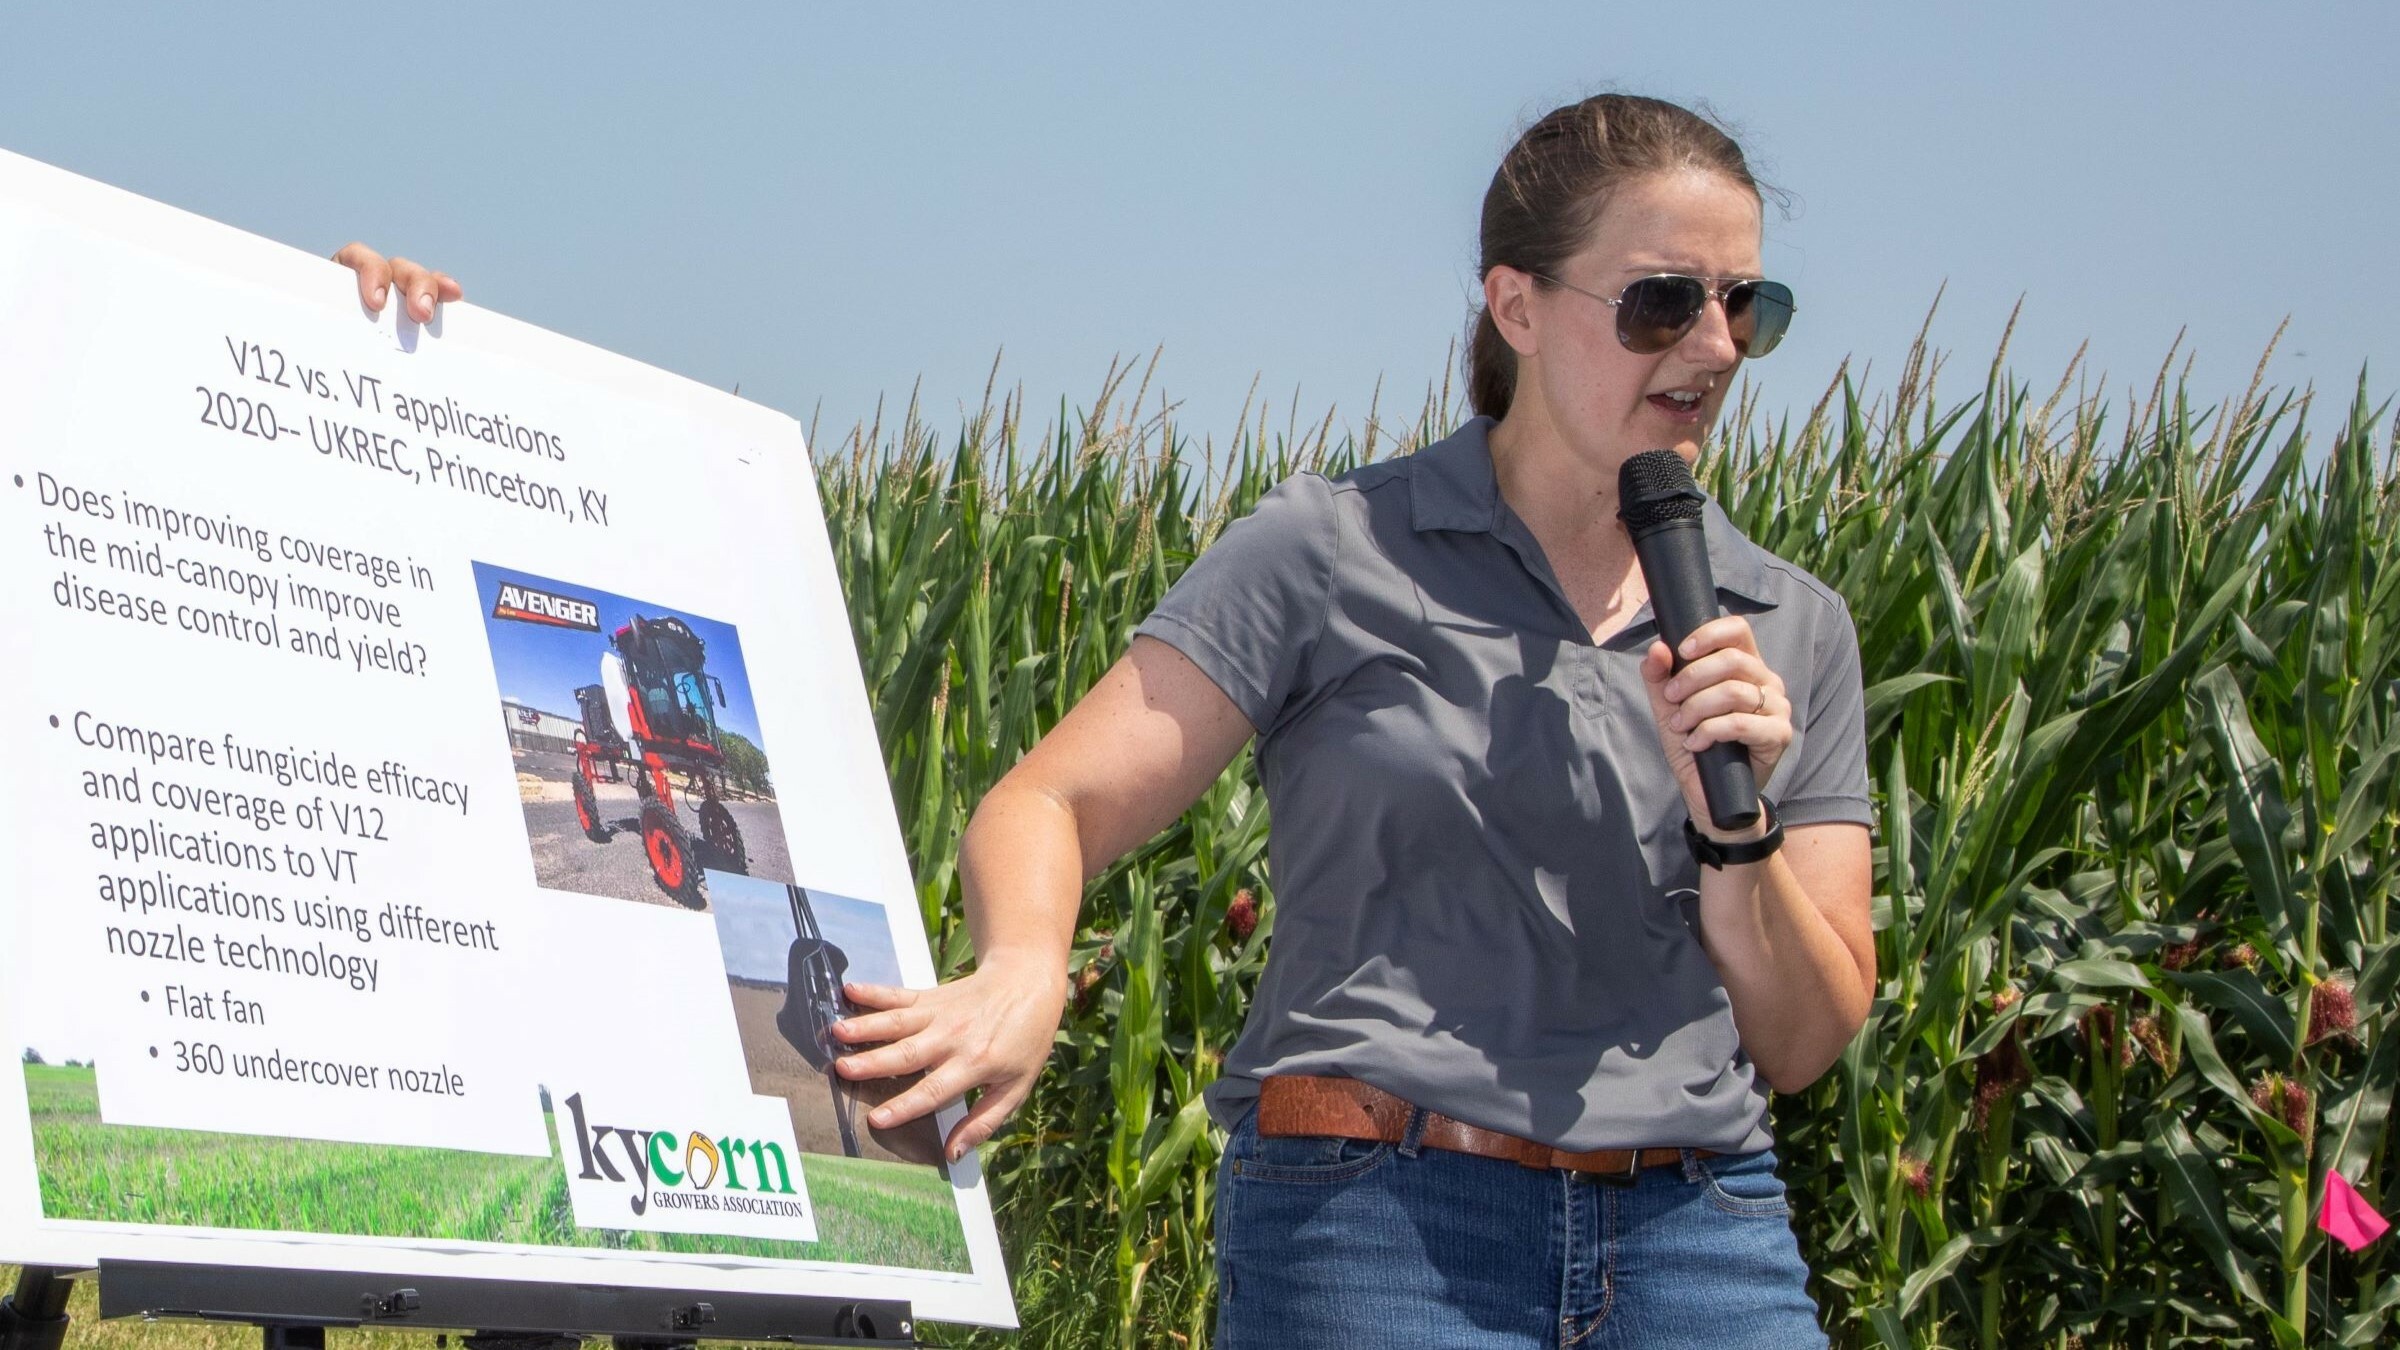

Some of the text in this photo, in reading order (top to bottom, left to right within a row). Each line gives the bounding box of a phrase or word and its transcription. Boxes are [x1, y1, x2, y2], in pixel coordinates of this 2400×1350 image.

[226, 336, 564, 461] V12 vs. VT applications
[309, 416, 421, 484] UKREC,
[427, 448, 574, 523] Princeton,
[579, 487, 608, 526] KY
[38, 472, 433, 591] Does improving coverage in
[44, 524, 401, 627] the mid-canopy improve
[500, 585, 597, 627] AVENGER
[53, 572, 426, 677] disease control and yield?
[74, 711, 469, 815] Compare fungicide efficacy
[83, 767, 388, 841] and coverage of V12
[91, 819, 358, 884] applications to VT
[99, 871, 499, 950] applications using different
[107, 924, 378, 992] nozzle technology
[165, 985, 264, 1025] Flat fan
[174, 1041, 465, 1096] 360 undercover nozzle
[653, 1191, 803, 1217] GROWERS ASSOCIATION
